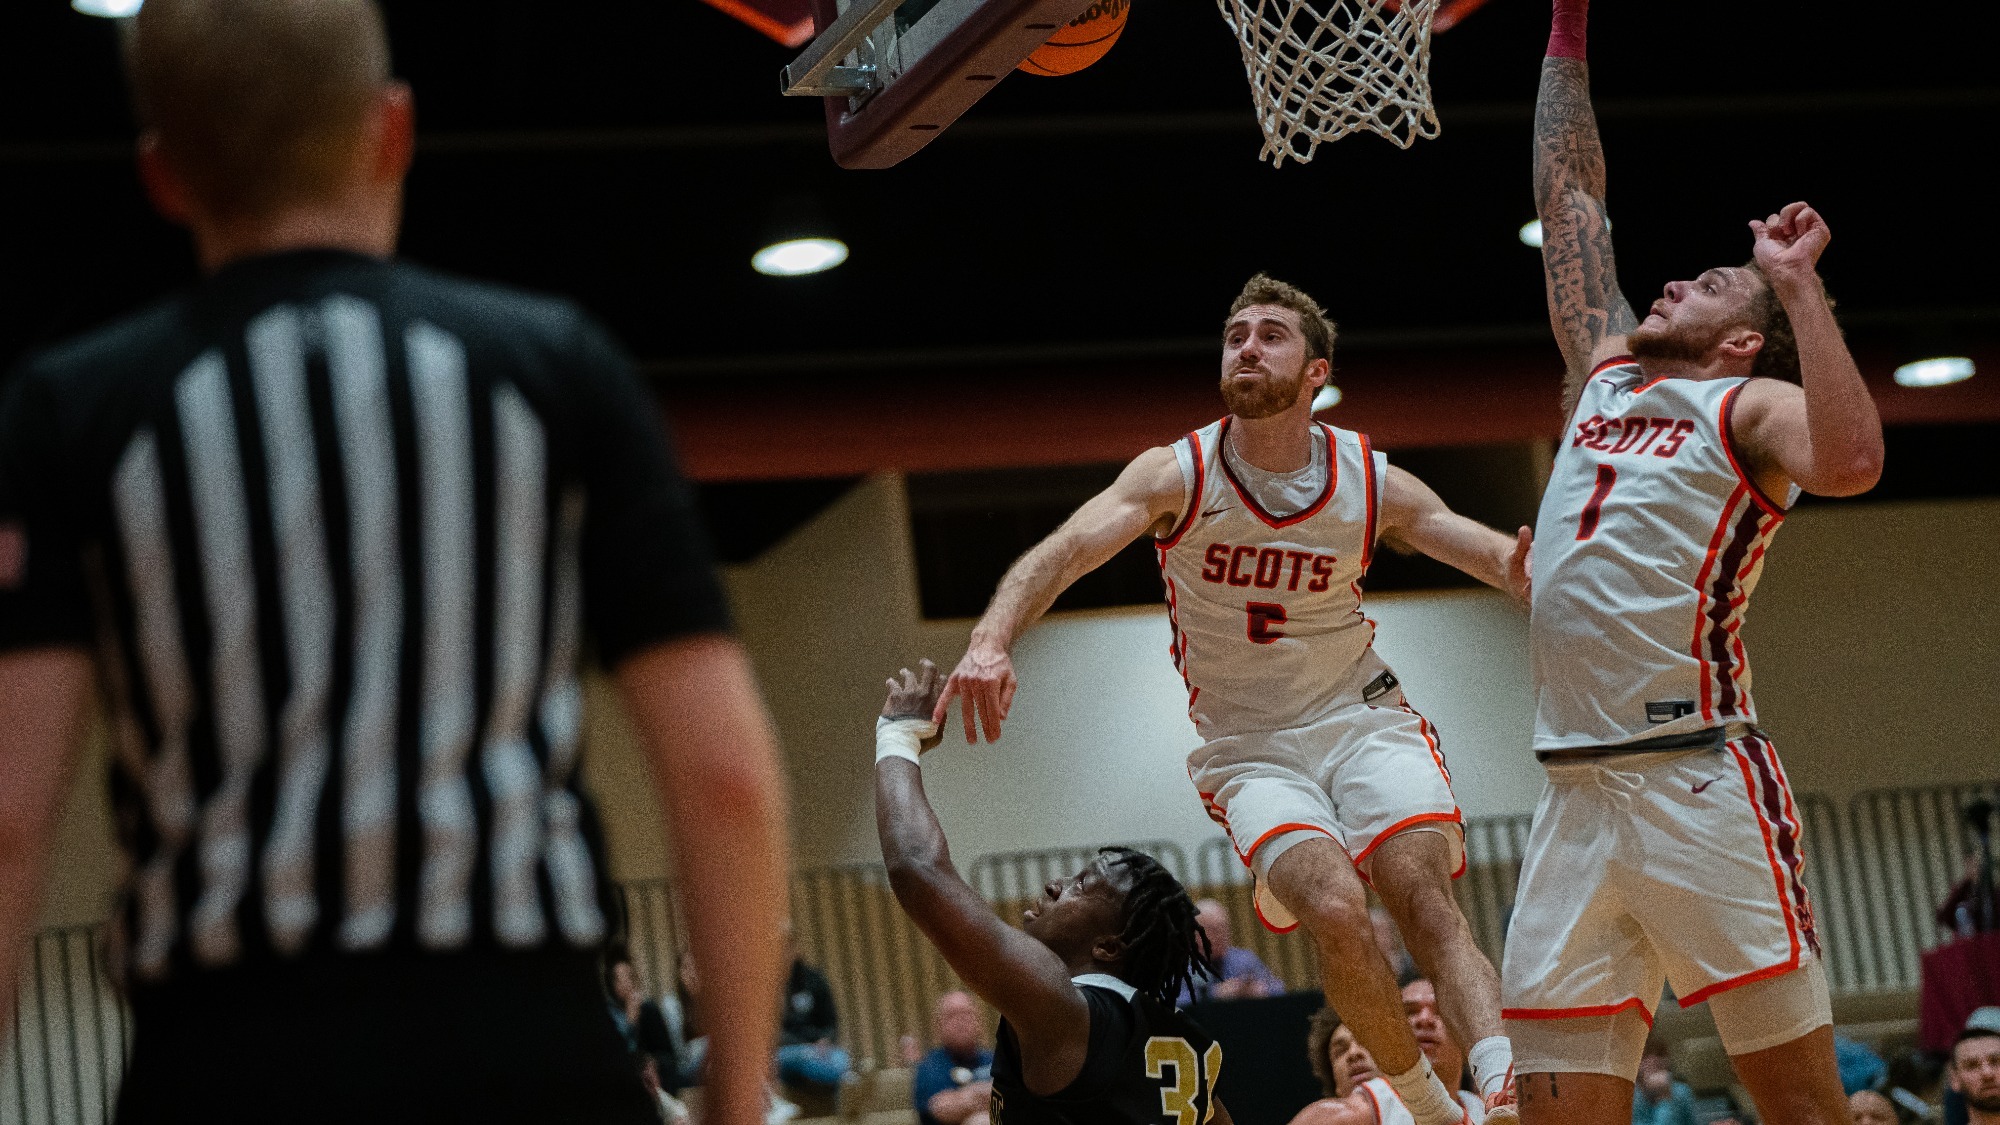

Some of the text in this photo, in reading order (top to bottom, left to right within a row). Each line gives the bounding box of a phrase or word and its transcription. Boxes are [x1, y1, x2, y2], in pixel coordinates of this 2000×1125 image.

[1573, 414, 1696, 459] SCOTS
[1575, 463, 1618, 541] 1
[1201, 543, 1338, 593] SCOTS
